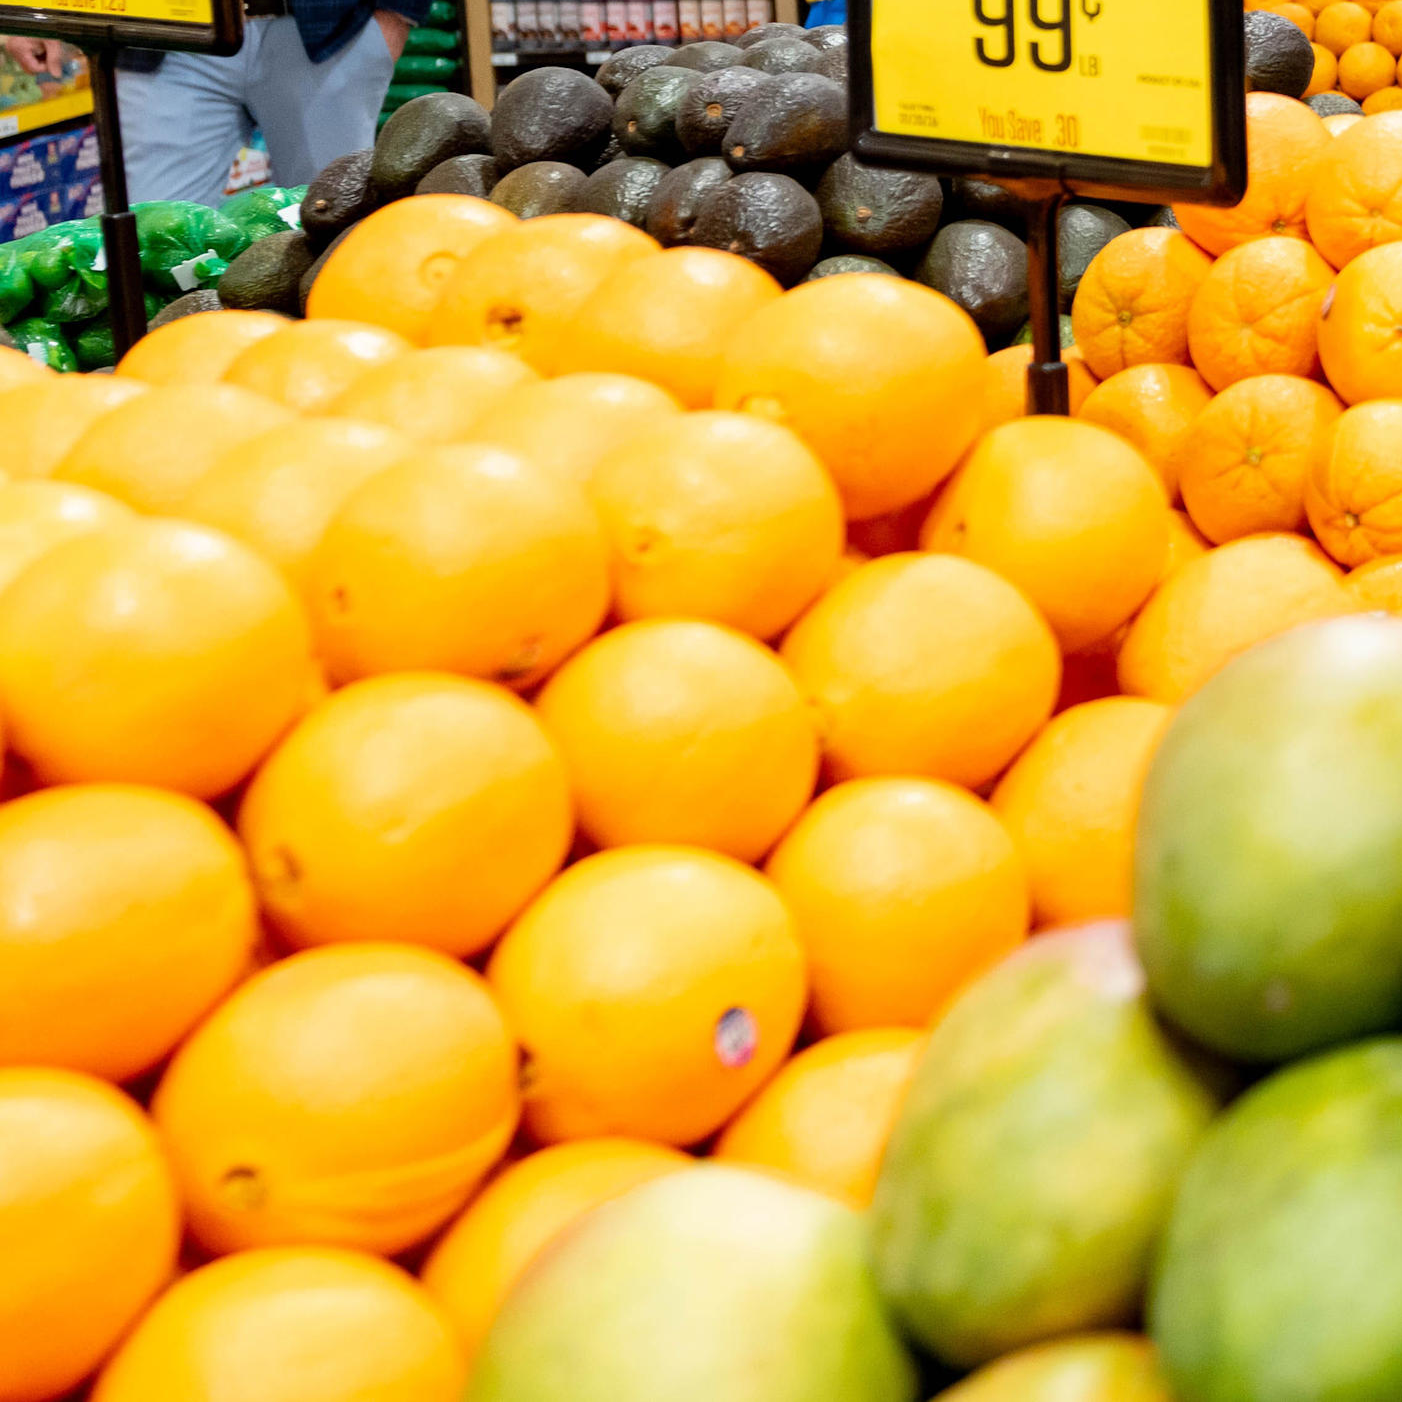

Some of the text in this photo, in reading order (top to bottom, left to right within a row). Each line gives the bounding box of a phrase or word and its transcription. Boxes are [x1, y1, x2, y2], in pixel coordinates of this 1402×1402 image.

[1079, 55, 1101, 77] LB
[979, 108, 1005, 139] You
[1007, 109, 1042, 143] Save
